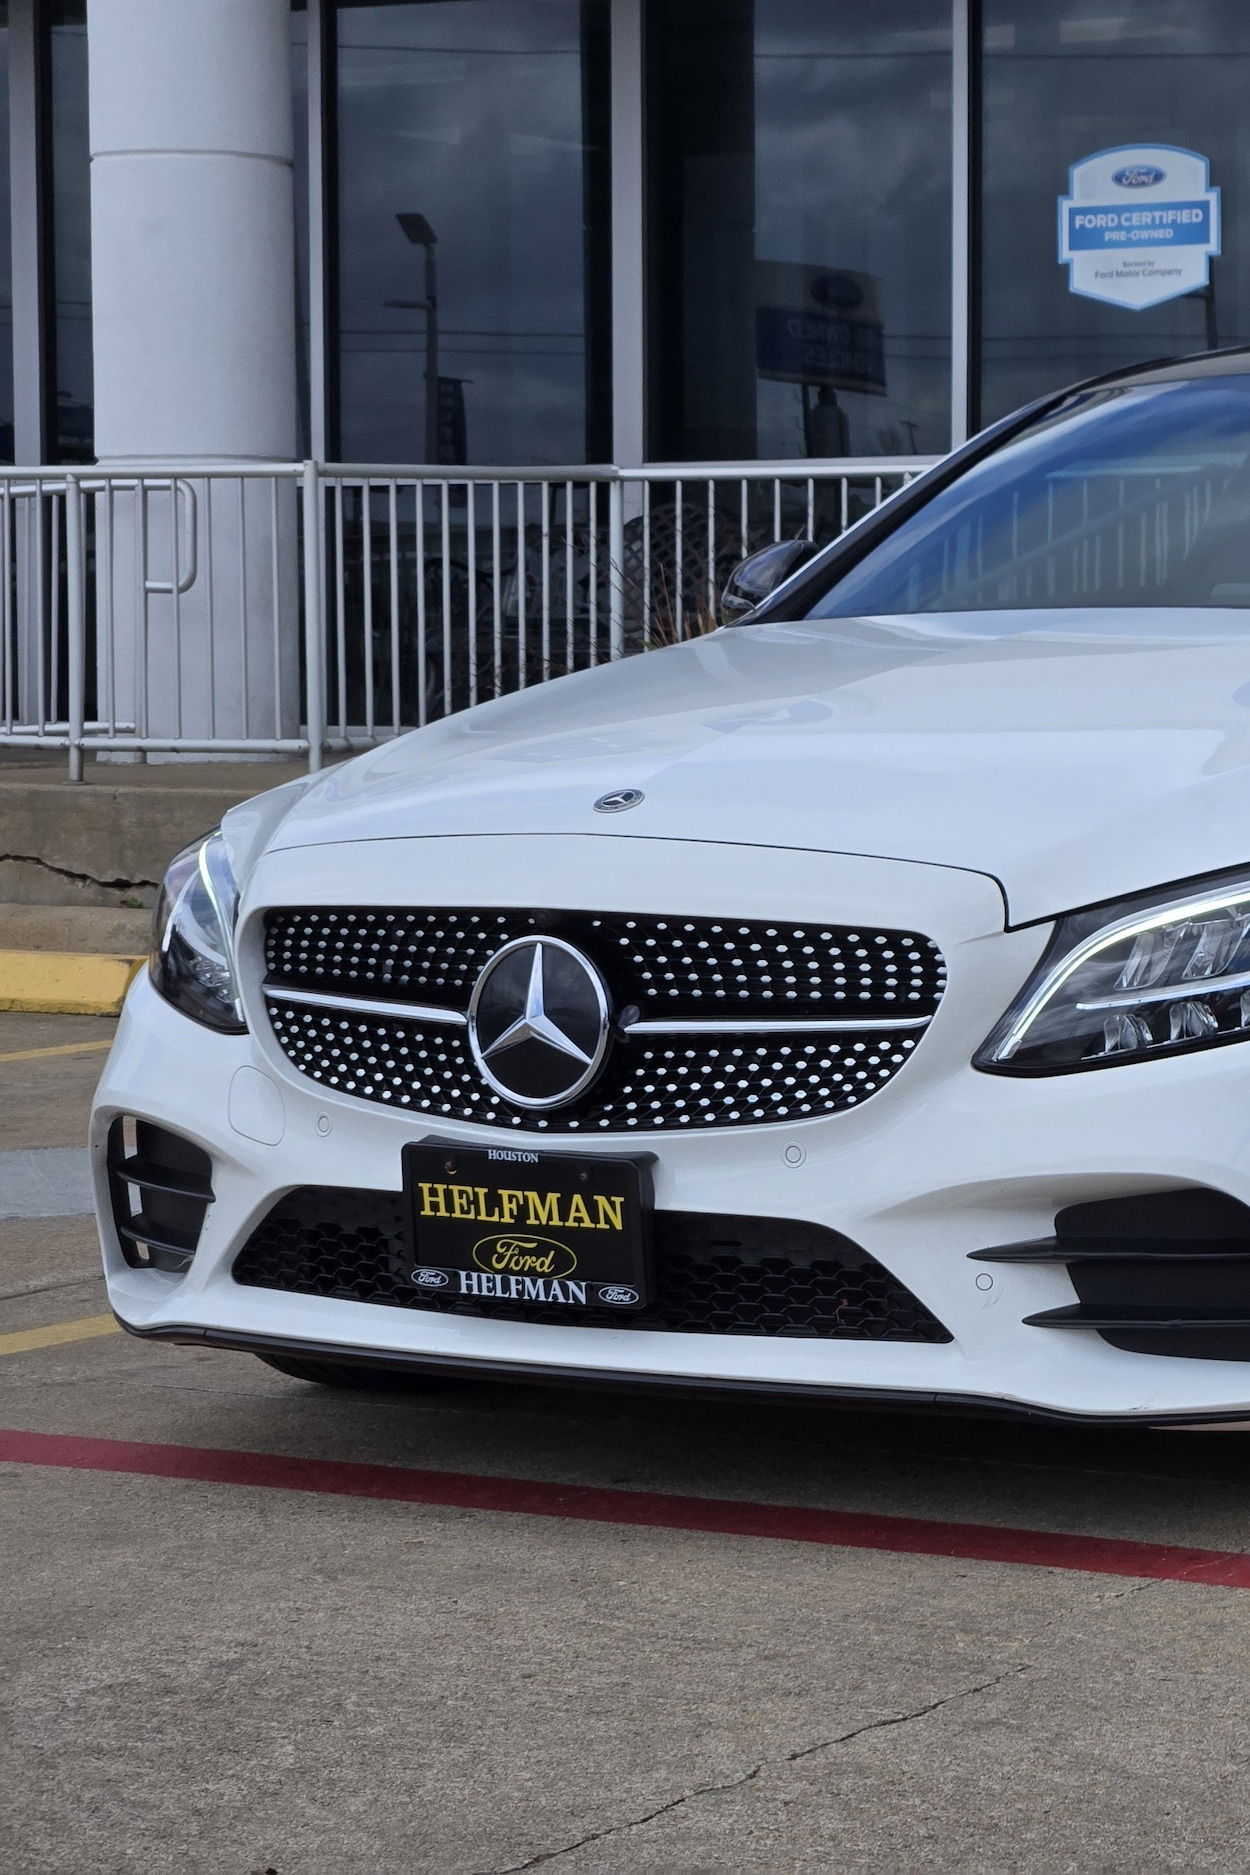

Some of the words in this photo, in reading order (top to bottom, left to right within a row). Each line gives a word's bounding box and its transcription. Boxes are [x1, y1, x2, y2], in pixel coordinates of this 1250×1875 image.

[1075, 214, 1118, 229] FORD
[1121, 209, 1203, 226] CERTIFIED
[1104, 228, 1173, 242] PRE-OWNED
[1094, 270, 1114, 280] Ford
[1115, 269, 1141, 279] Motor
[1142, 267, 1183, 277] Company
[487, 1149, 539, 1163] HOUSTON
[418, 1182, 625, 1231] HELFMAN
[491, 1238, 556, 1274] Ford
[458, 1270, 588, 1306] HELFMAN
